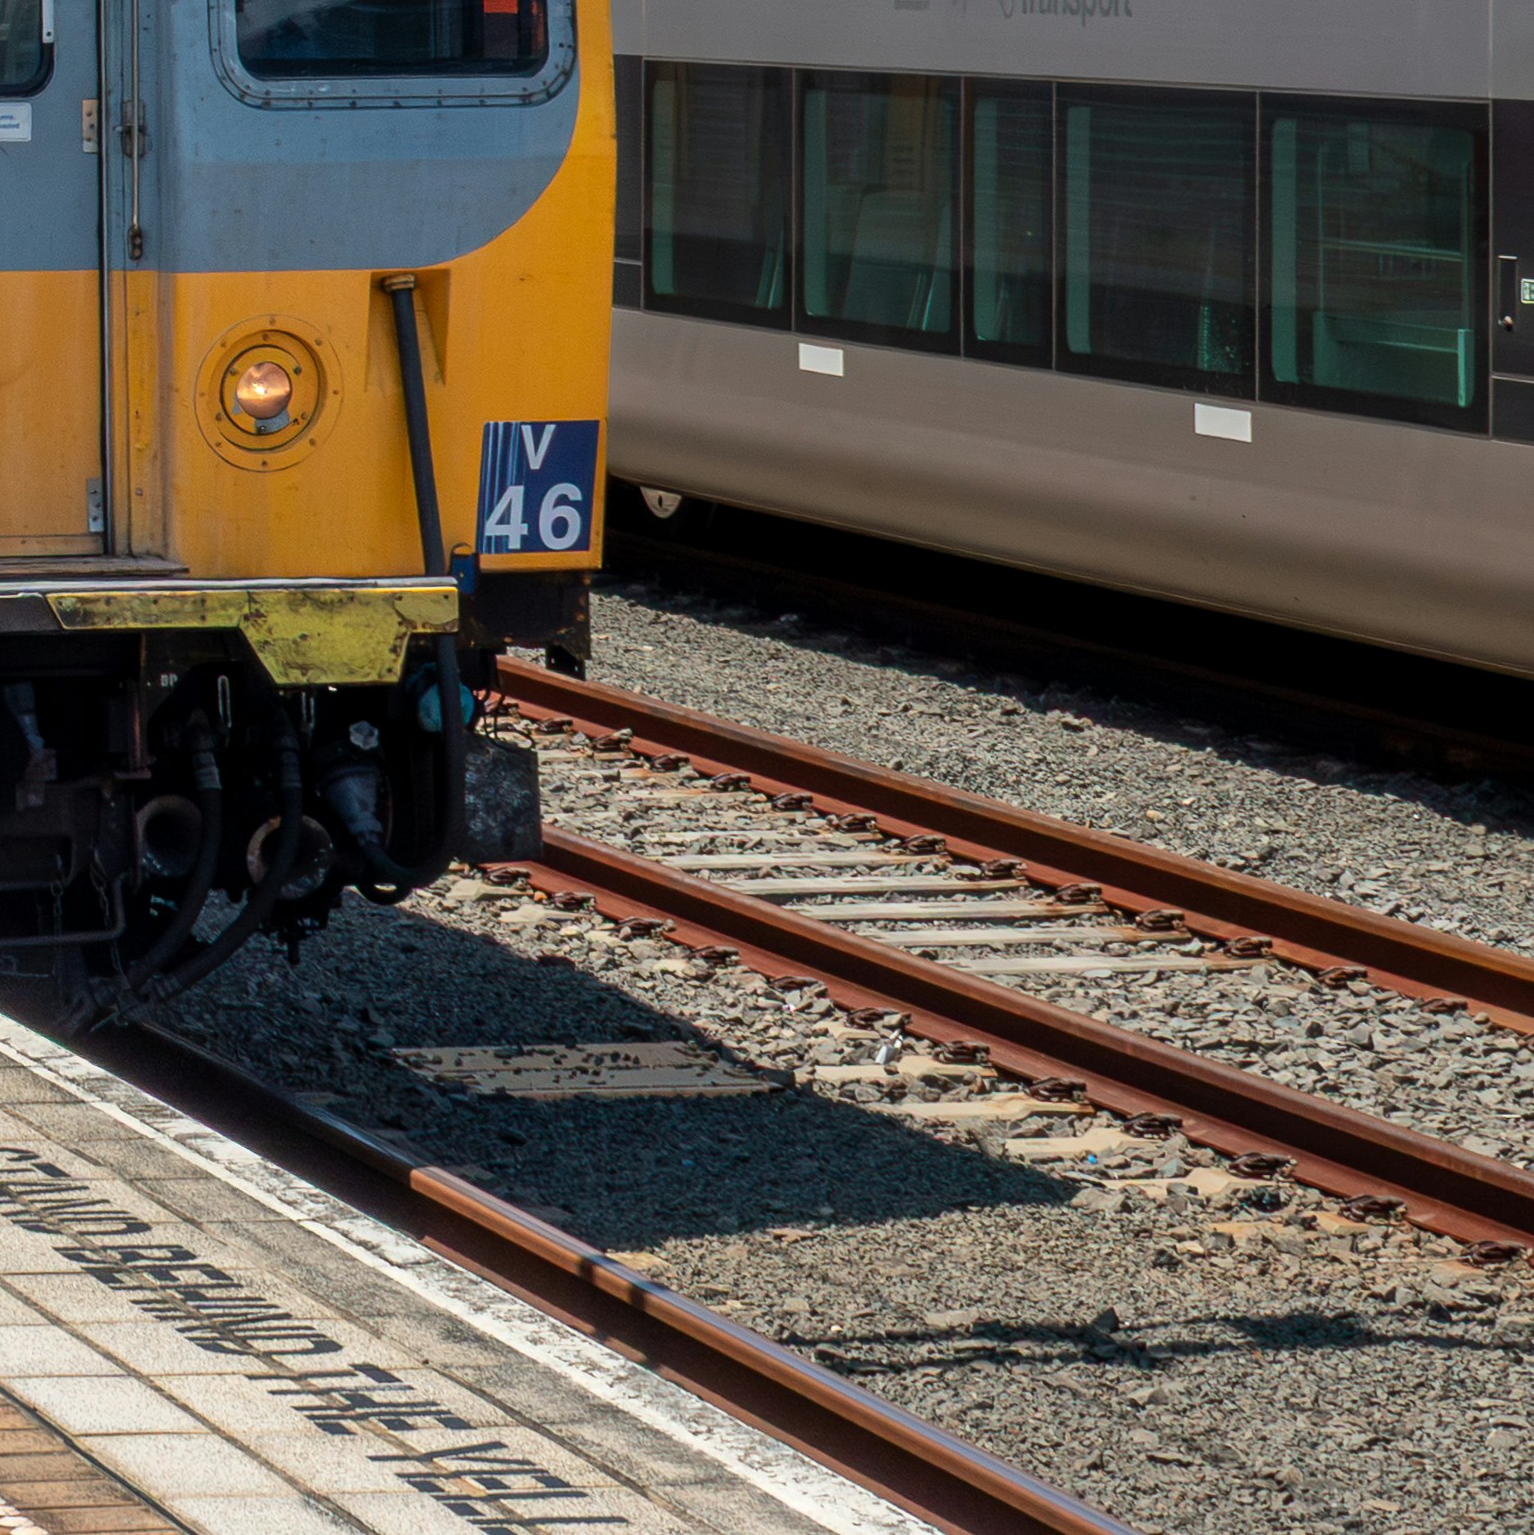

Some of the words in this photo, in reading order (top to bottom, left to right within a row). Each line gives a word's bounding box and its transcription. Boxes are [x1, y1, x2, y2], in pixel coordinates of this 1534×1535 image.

[520, 424, 557, 470] V
[484, 482, 583, 551] 46
[52, 1243, 344, 1356] BEHIND
[245, 1362, 478, 1436] THE
